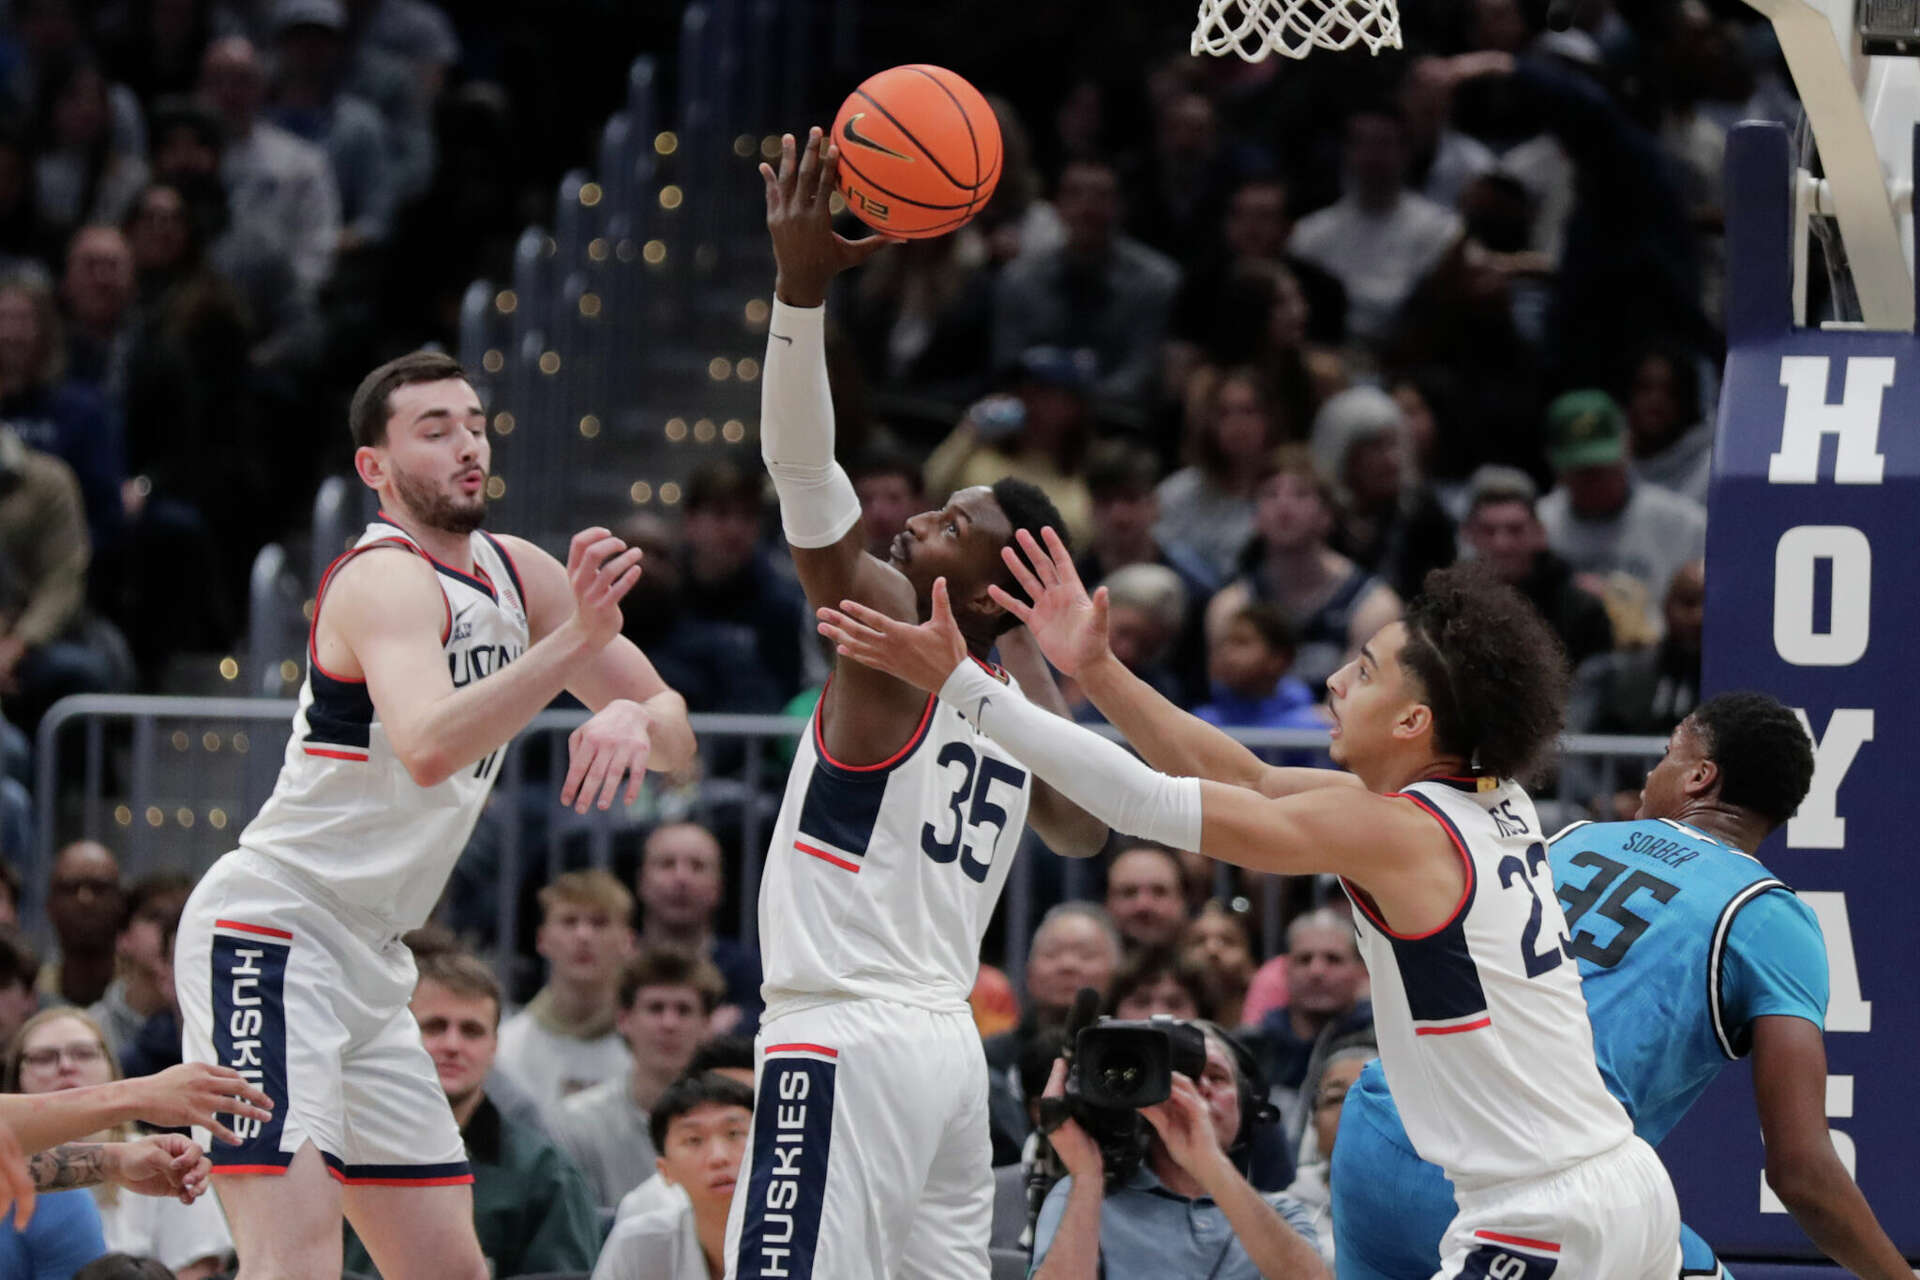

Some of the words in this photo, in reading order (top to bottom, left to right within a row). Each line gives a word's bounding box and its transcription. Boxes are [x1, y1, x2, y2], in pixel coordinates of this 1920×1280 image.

[920, 741, 1027, 884] 35
[1622, 831, 1700, 869] SORBER
[1555, 851, 1682, 969] 35
[760, 1071, 811, 1278] HUSKIES
